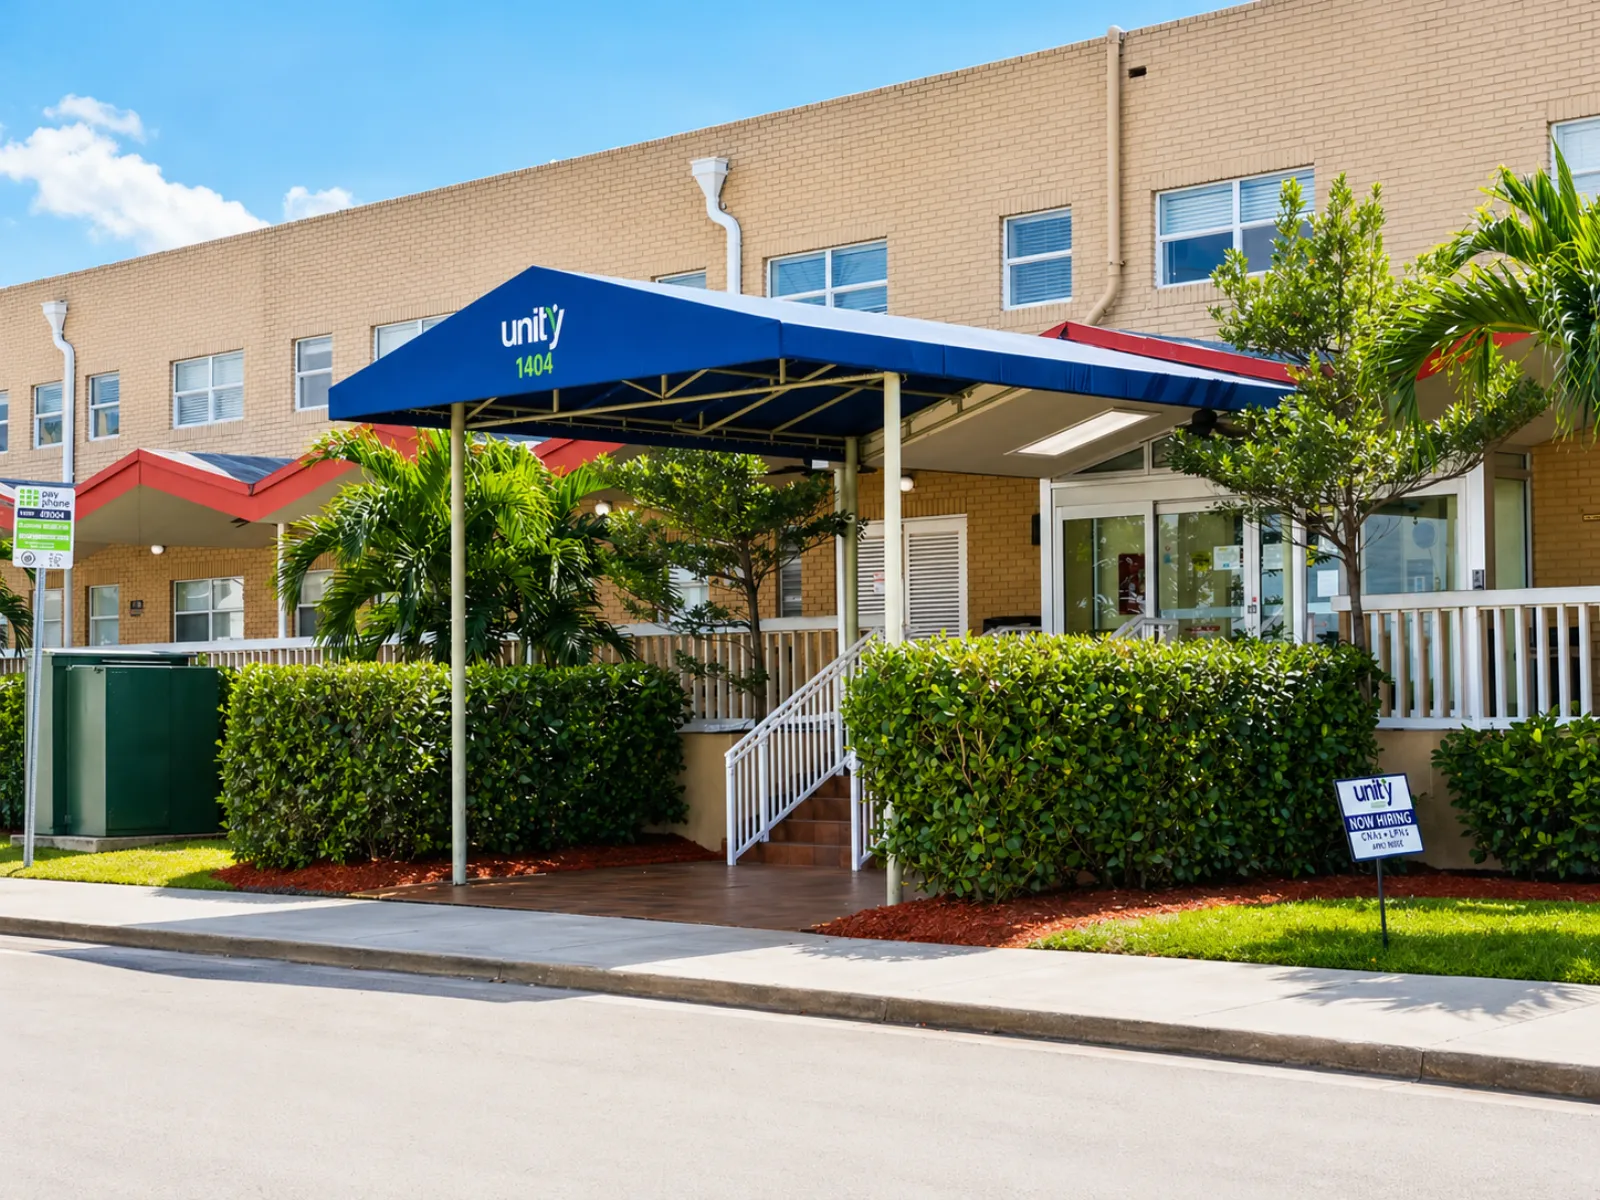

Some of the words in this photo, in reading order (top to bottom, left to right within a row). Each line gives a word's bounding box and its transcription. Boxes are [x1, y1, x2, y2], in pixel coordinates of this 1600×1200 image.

[501, 303, 565, 350] unity
[516, 348, 553, 379] 1404
[42, 491, 59, 499] pay
[1353, 778, 1392, 806] unity
[1349, 815, 1375, 831] NOW
[1377, 811, 1412, 827] HIRING
